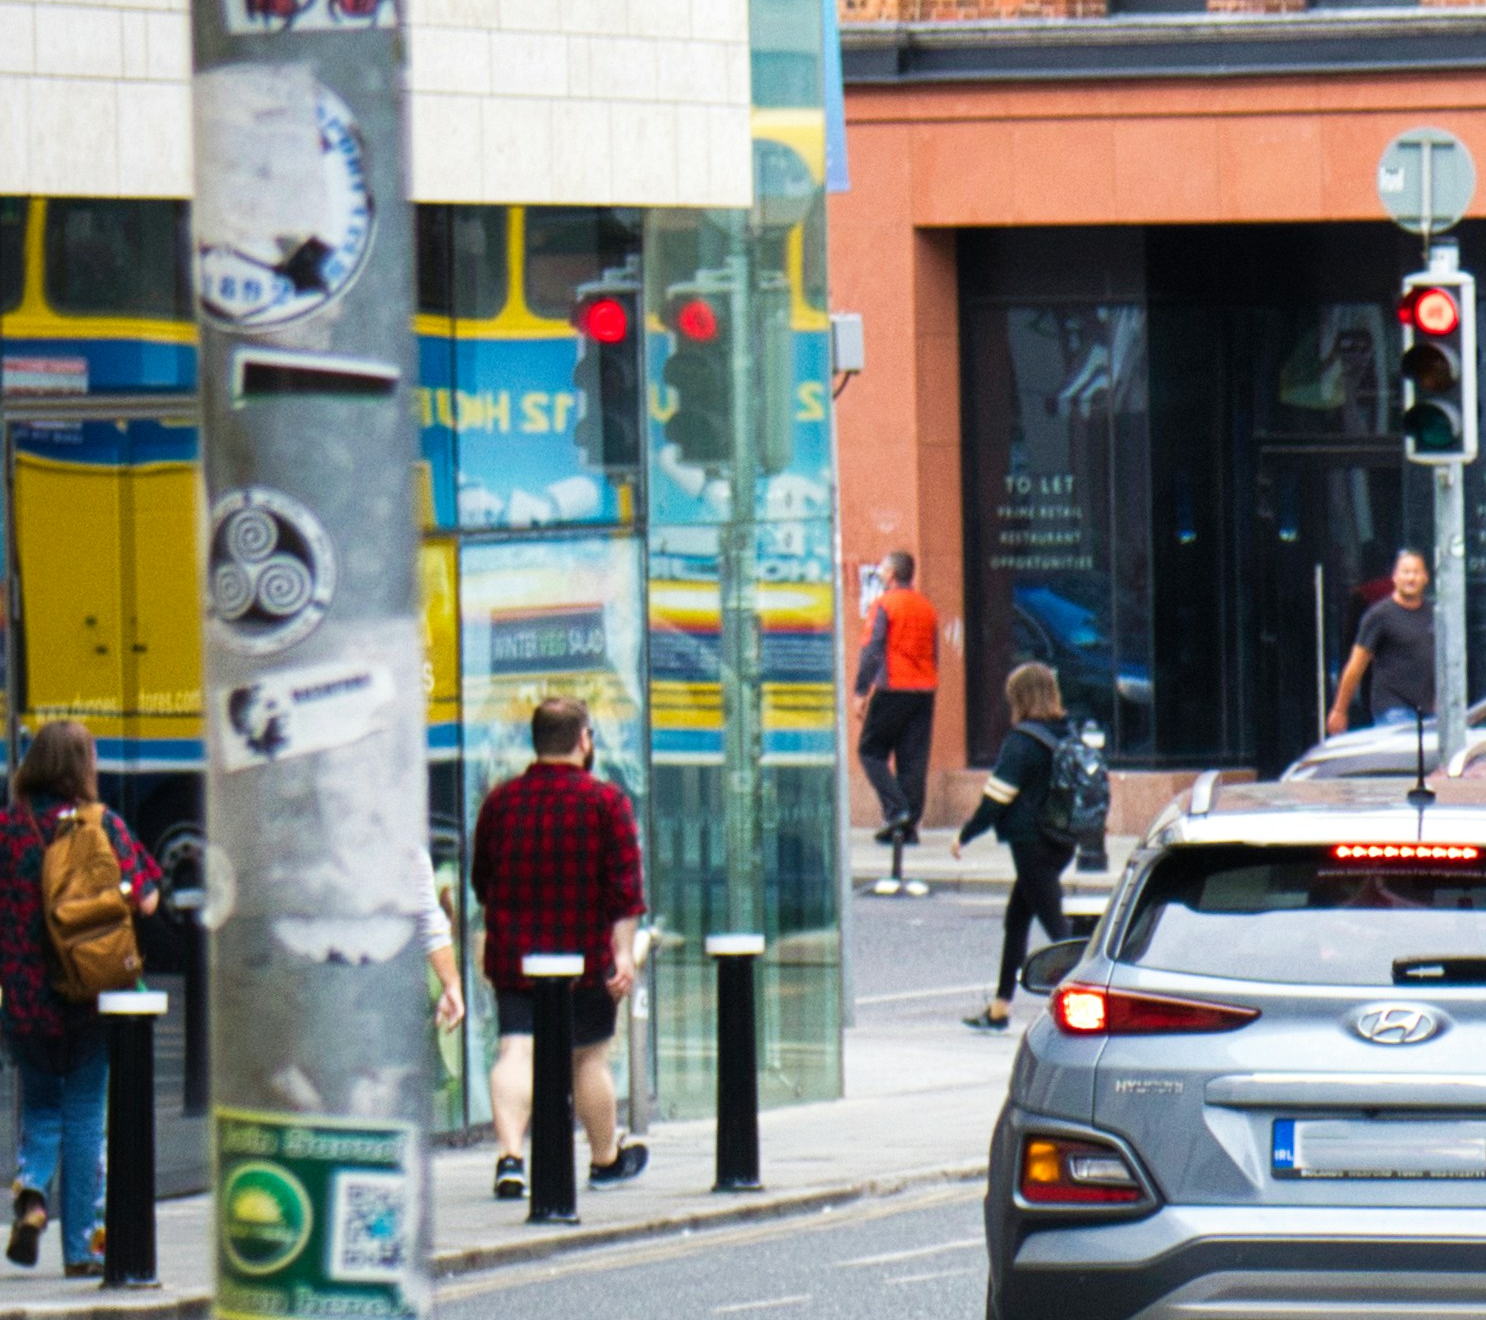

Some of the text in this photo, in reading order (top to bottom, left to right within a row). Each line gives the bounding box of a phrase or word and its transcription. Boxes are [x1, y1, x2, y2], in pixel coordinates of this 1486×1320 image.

[1005, 474, 1074, 495] TO LET
[1274, 1149, 1295, 1162] IRL
